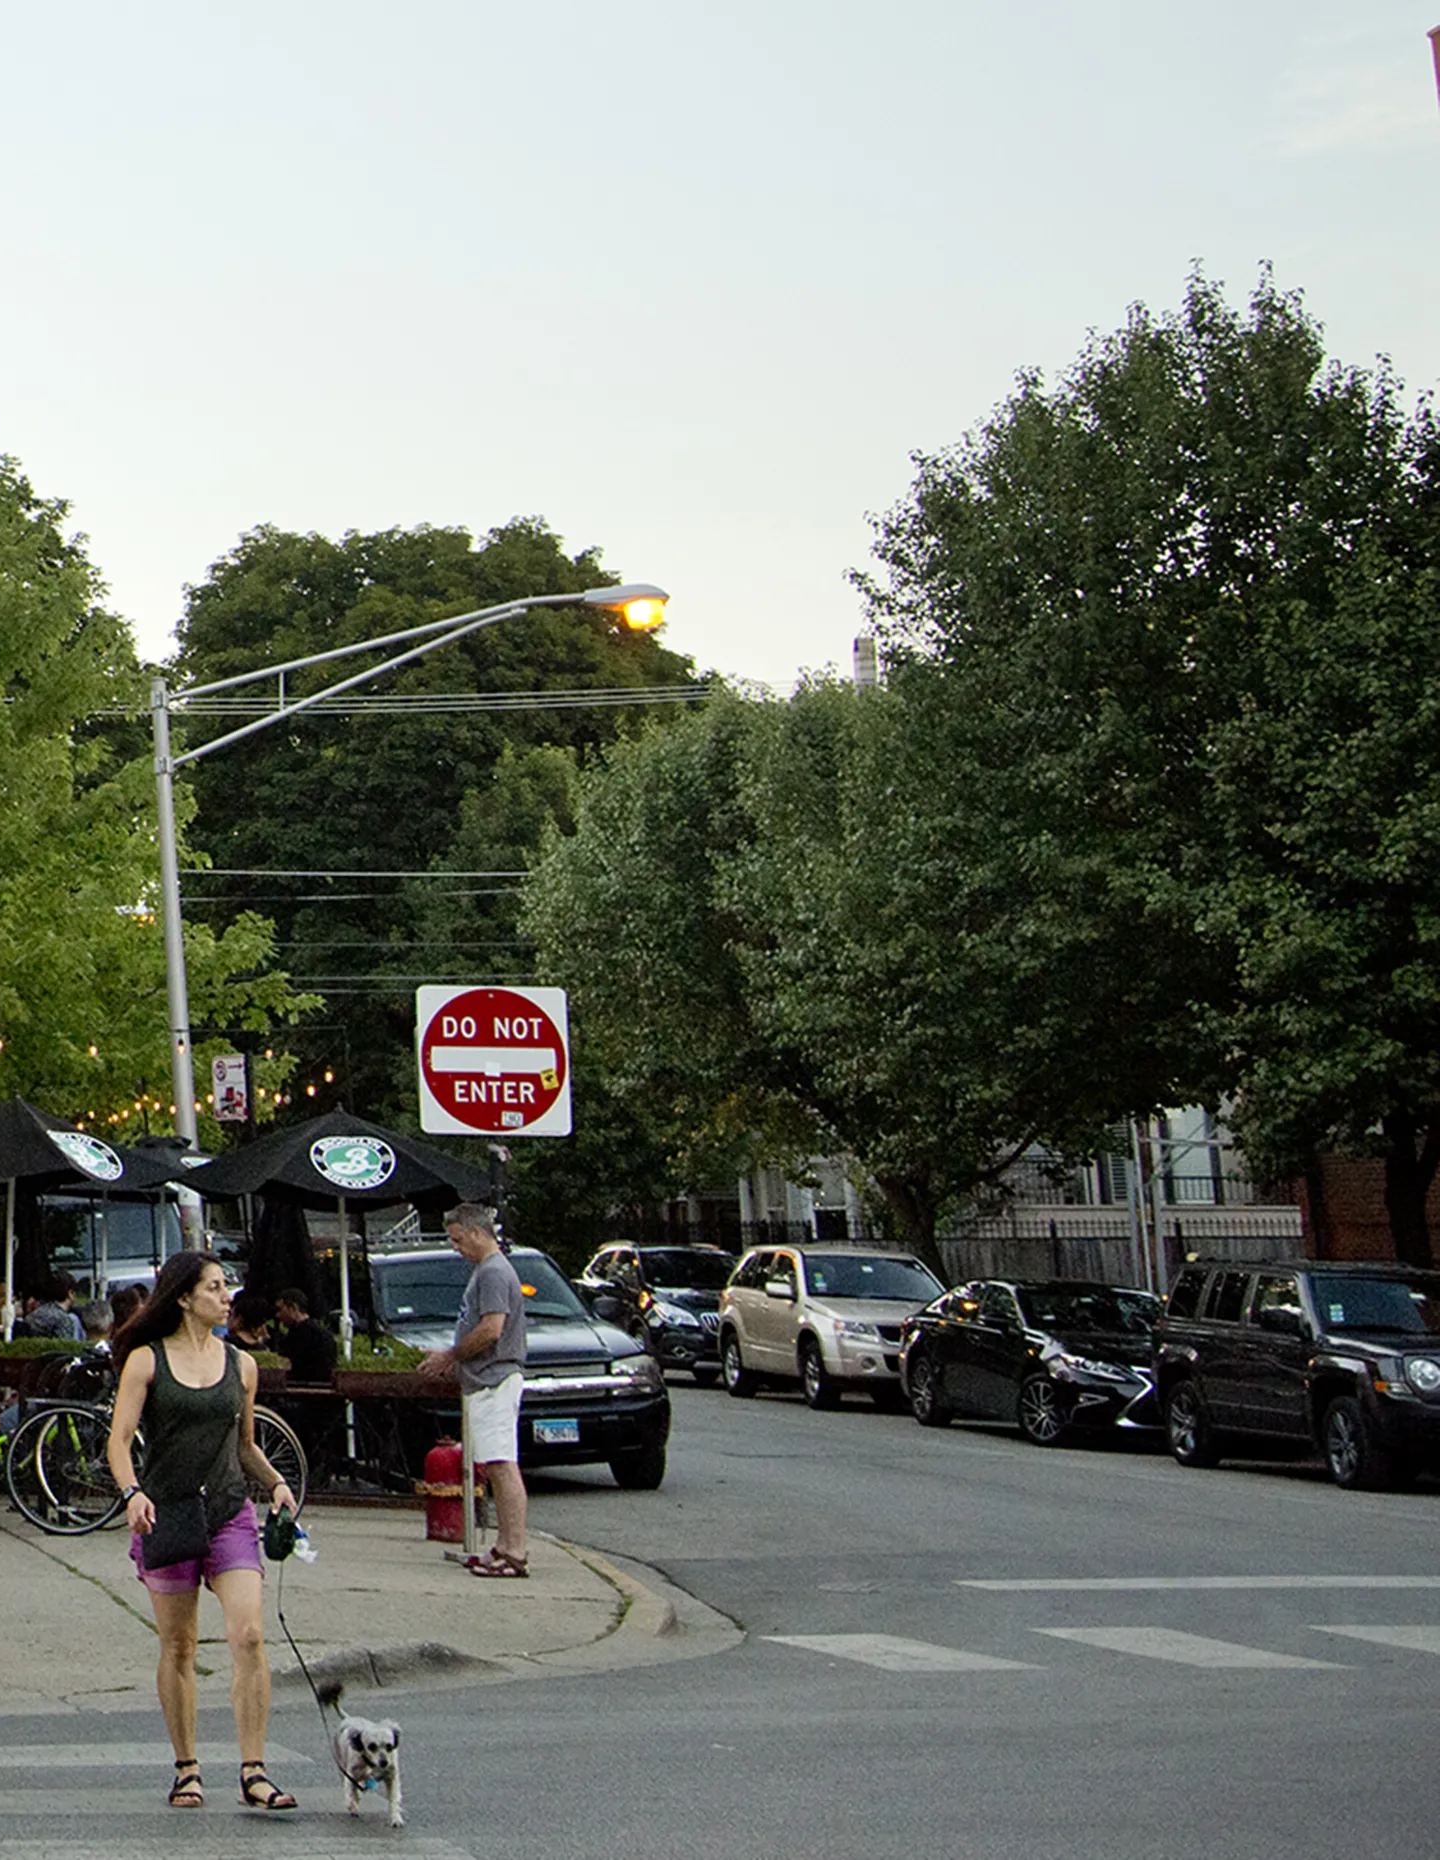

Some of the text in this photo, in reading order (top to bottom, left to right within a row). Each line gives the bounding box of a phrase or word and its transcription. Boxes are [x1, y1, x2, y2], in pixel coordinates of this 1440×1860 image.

[442, 1016, 543, 1040] DO NOT
[454, 1080, 536, 1104] ENTER
